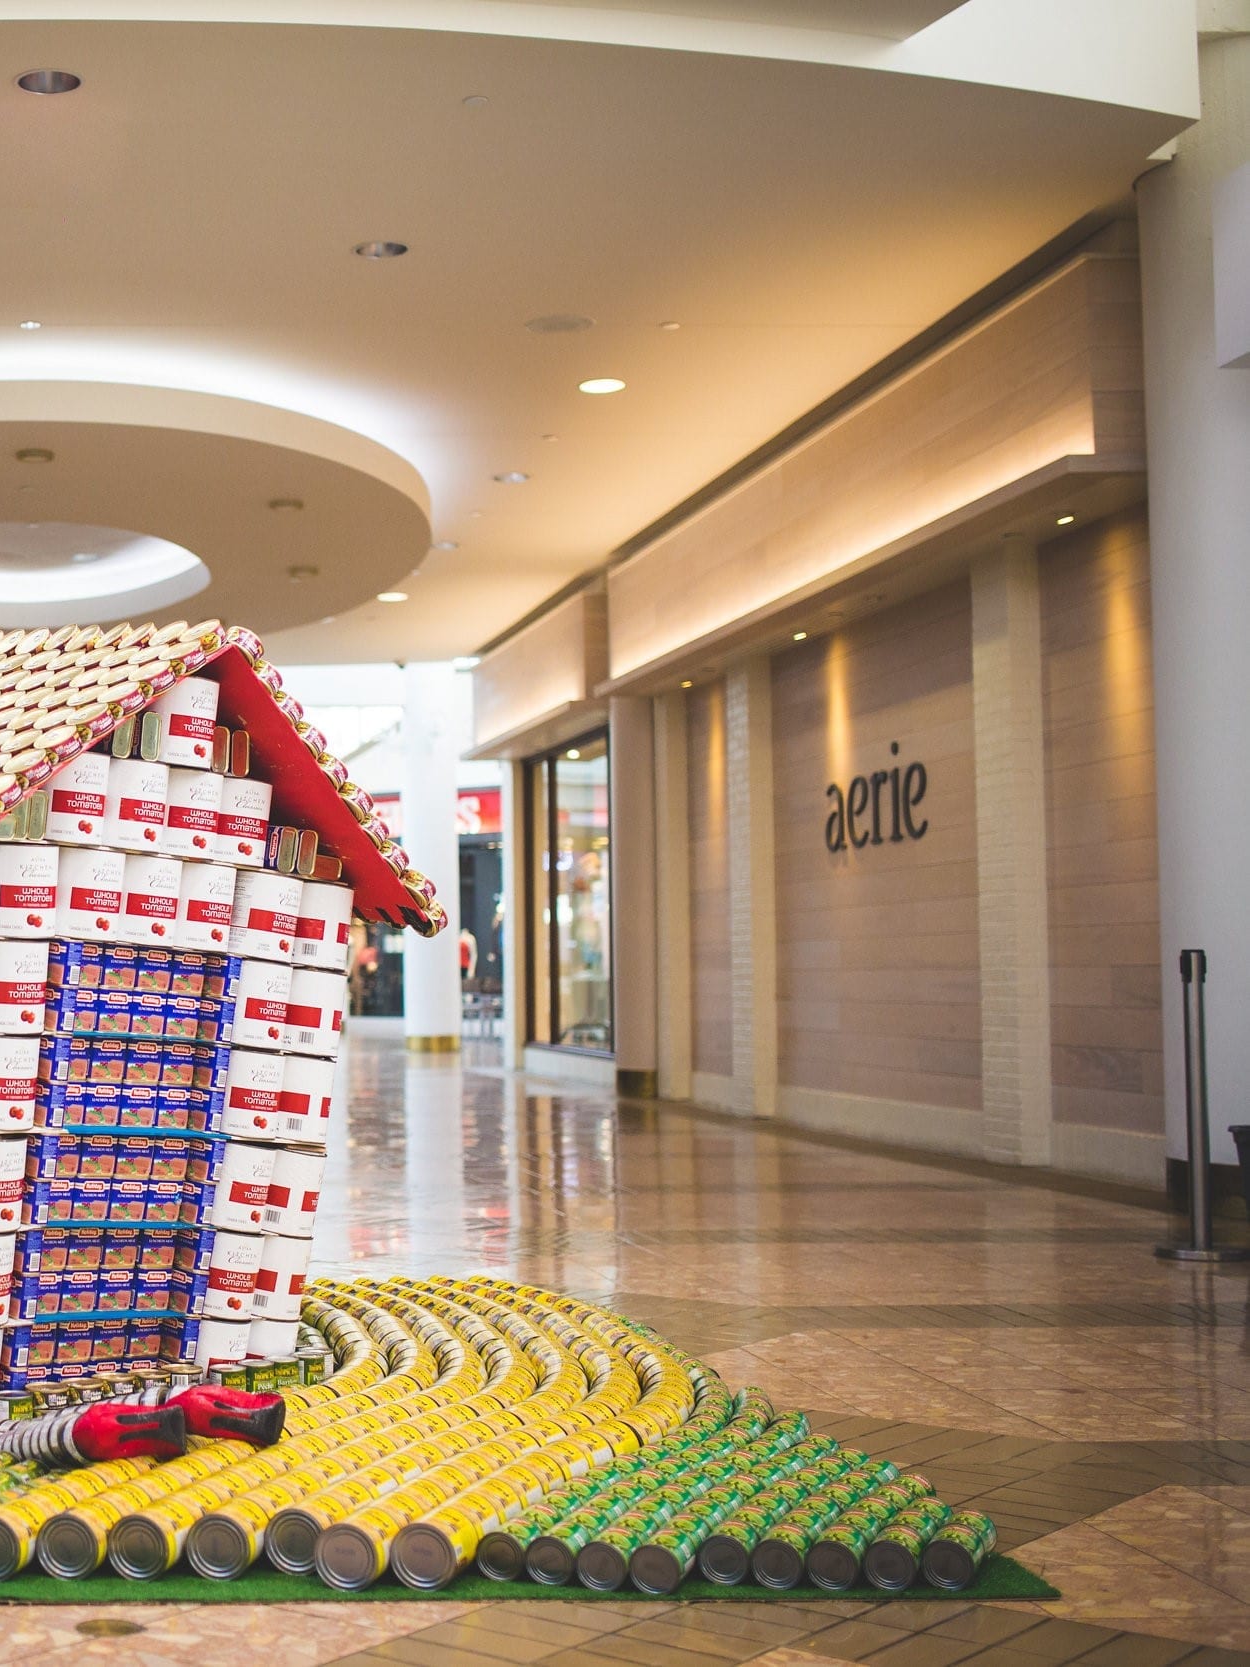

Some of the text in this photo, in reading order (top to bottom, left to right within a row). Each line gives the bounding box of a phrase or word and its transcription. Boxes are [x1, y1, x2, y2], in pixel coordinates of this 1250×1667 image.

[75, 794, 100, 803] WHOLE
[825, 741, 928, 853] aerie
[67, 800, 103, 810] TOMATOES
[190, 810, 214, 819] WHOLE
[235, 817, 260, 827] WHOLE
[227, 823, 263, 834] TOMATOES
[22, 887, 49, 896] WHOLE
[93, 891, 118, 899] WHOLE
[13, 894, 53, 903] TOMATOES
[148, 897, 173, 906] WHOLE
[5, 1079, 31, 1087] WHOLE
[251, 1091, 275, 1099] WHOLE
[226, 1272, 251, 1281] WHOLE
[219, 1277, 254, 1288] TOMATOES
